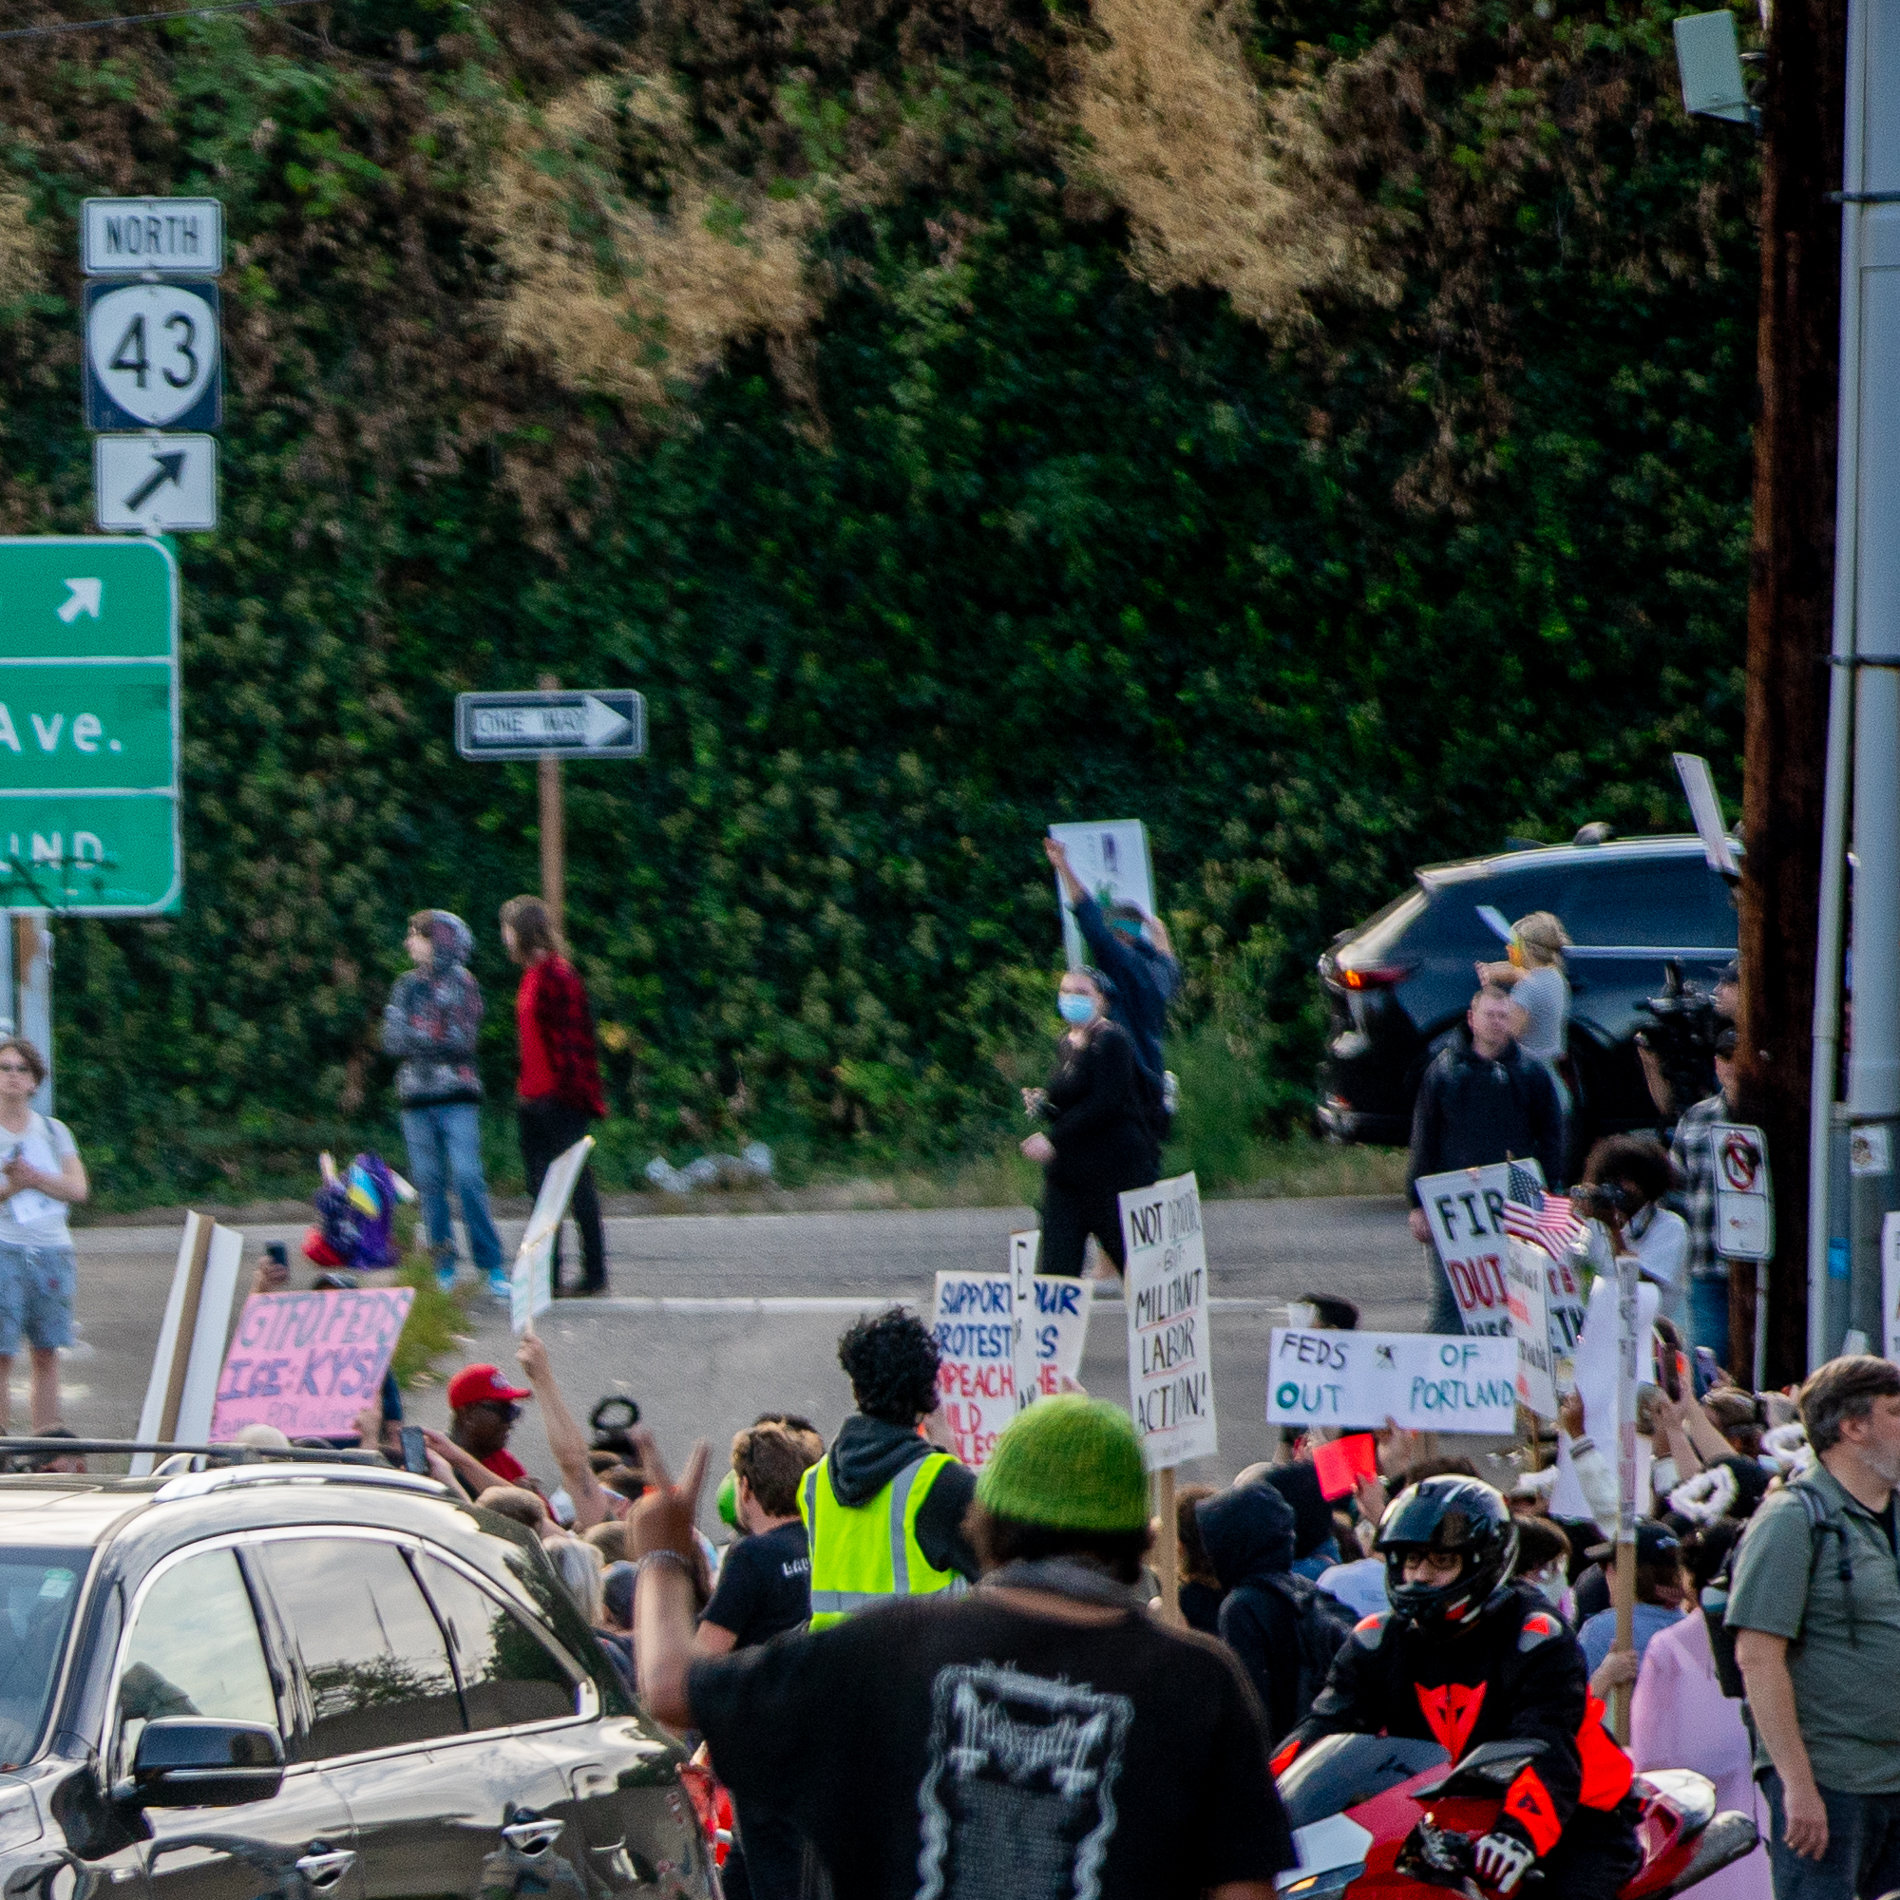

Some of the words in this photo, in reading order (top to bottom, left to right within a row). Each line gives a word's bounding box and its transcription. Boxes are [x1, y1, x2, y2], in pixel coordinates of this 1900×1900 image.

[105, 214, 199, 256] NORTH
[108, 310, 199, 390] 43
[480, 711, 524, 733] ONE
[542, 709, 584, 732] WAY
[1130, 1201, 1163, 1247] NOT
[1134, 1267, 1203, 1328] MILITANT
[1142, 1315, 1196, 1375] LABOR
[1279, 1332, 1348, 1370] FEDS
[1439, 1342, 1480, 1376] OF
[1137, 1370, 1207, 1434] ACTION!
[1276, 1380, 1343, 1414] OUT
[1409, 1375, 1517, 1414] PORTLAND
